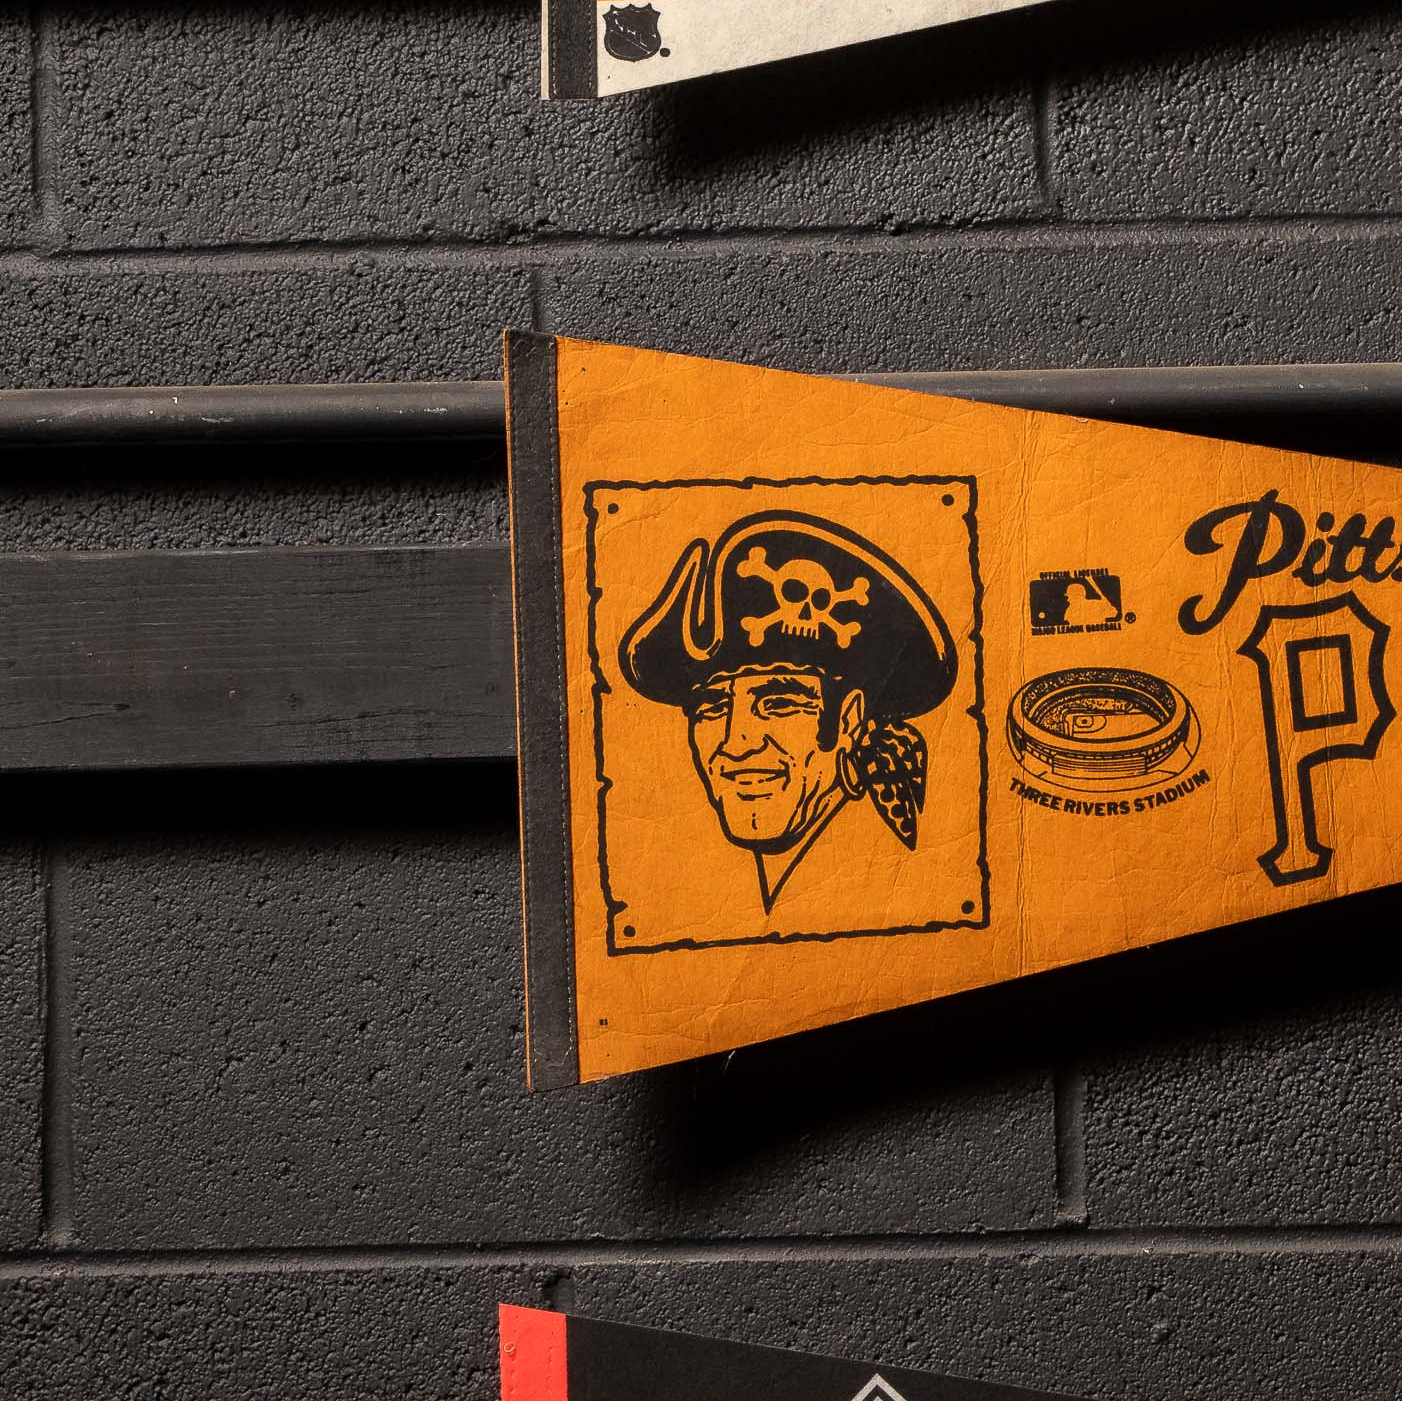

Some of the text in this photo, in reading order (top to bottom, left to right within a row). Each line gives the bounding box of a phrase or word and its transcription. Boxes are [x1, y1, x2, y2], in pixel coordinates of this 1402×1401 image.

[1009, 768, 1212, 818] THREE RIVERS STADIUM
